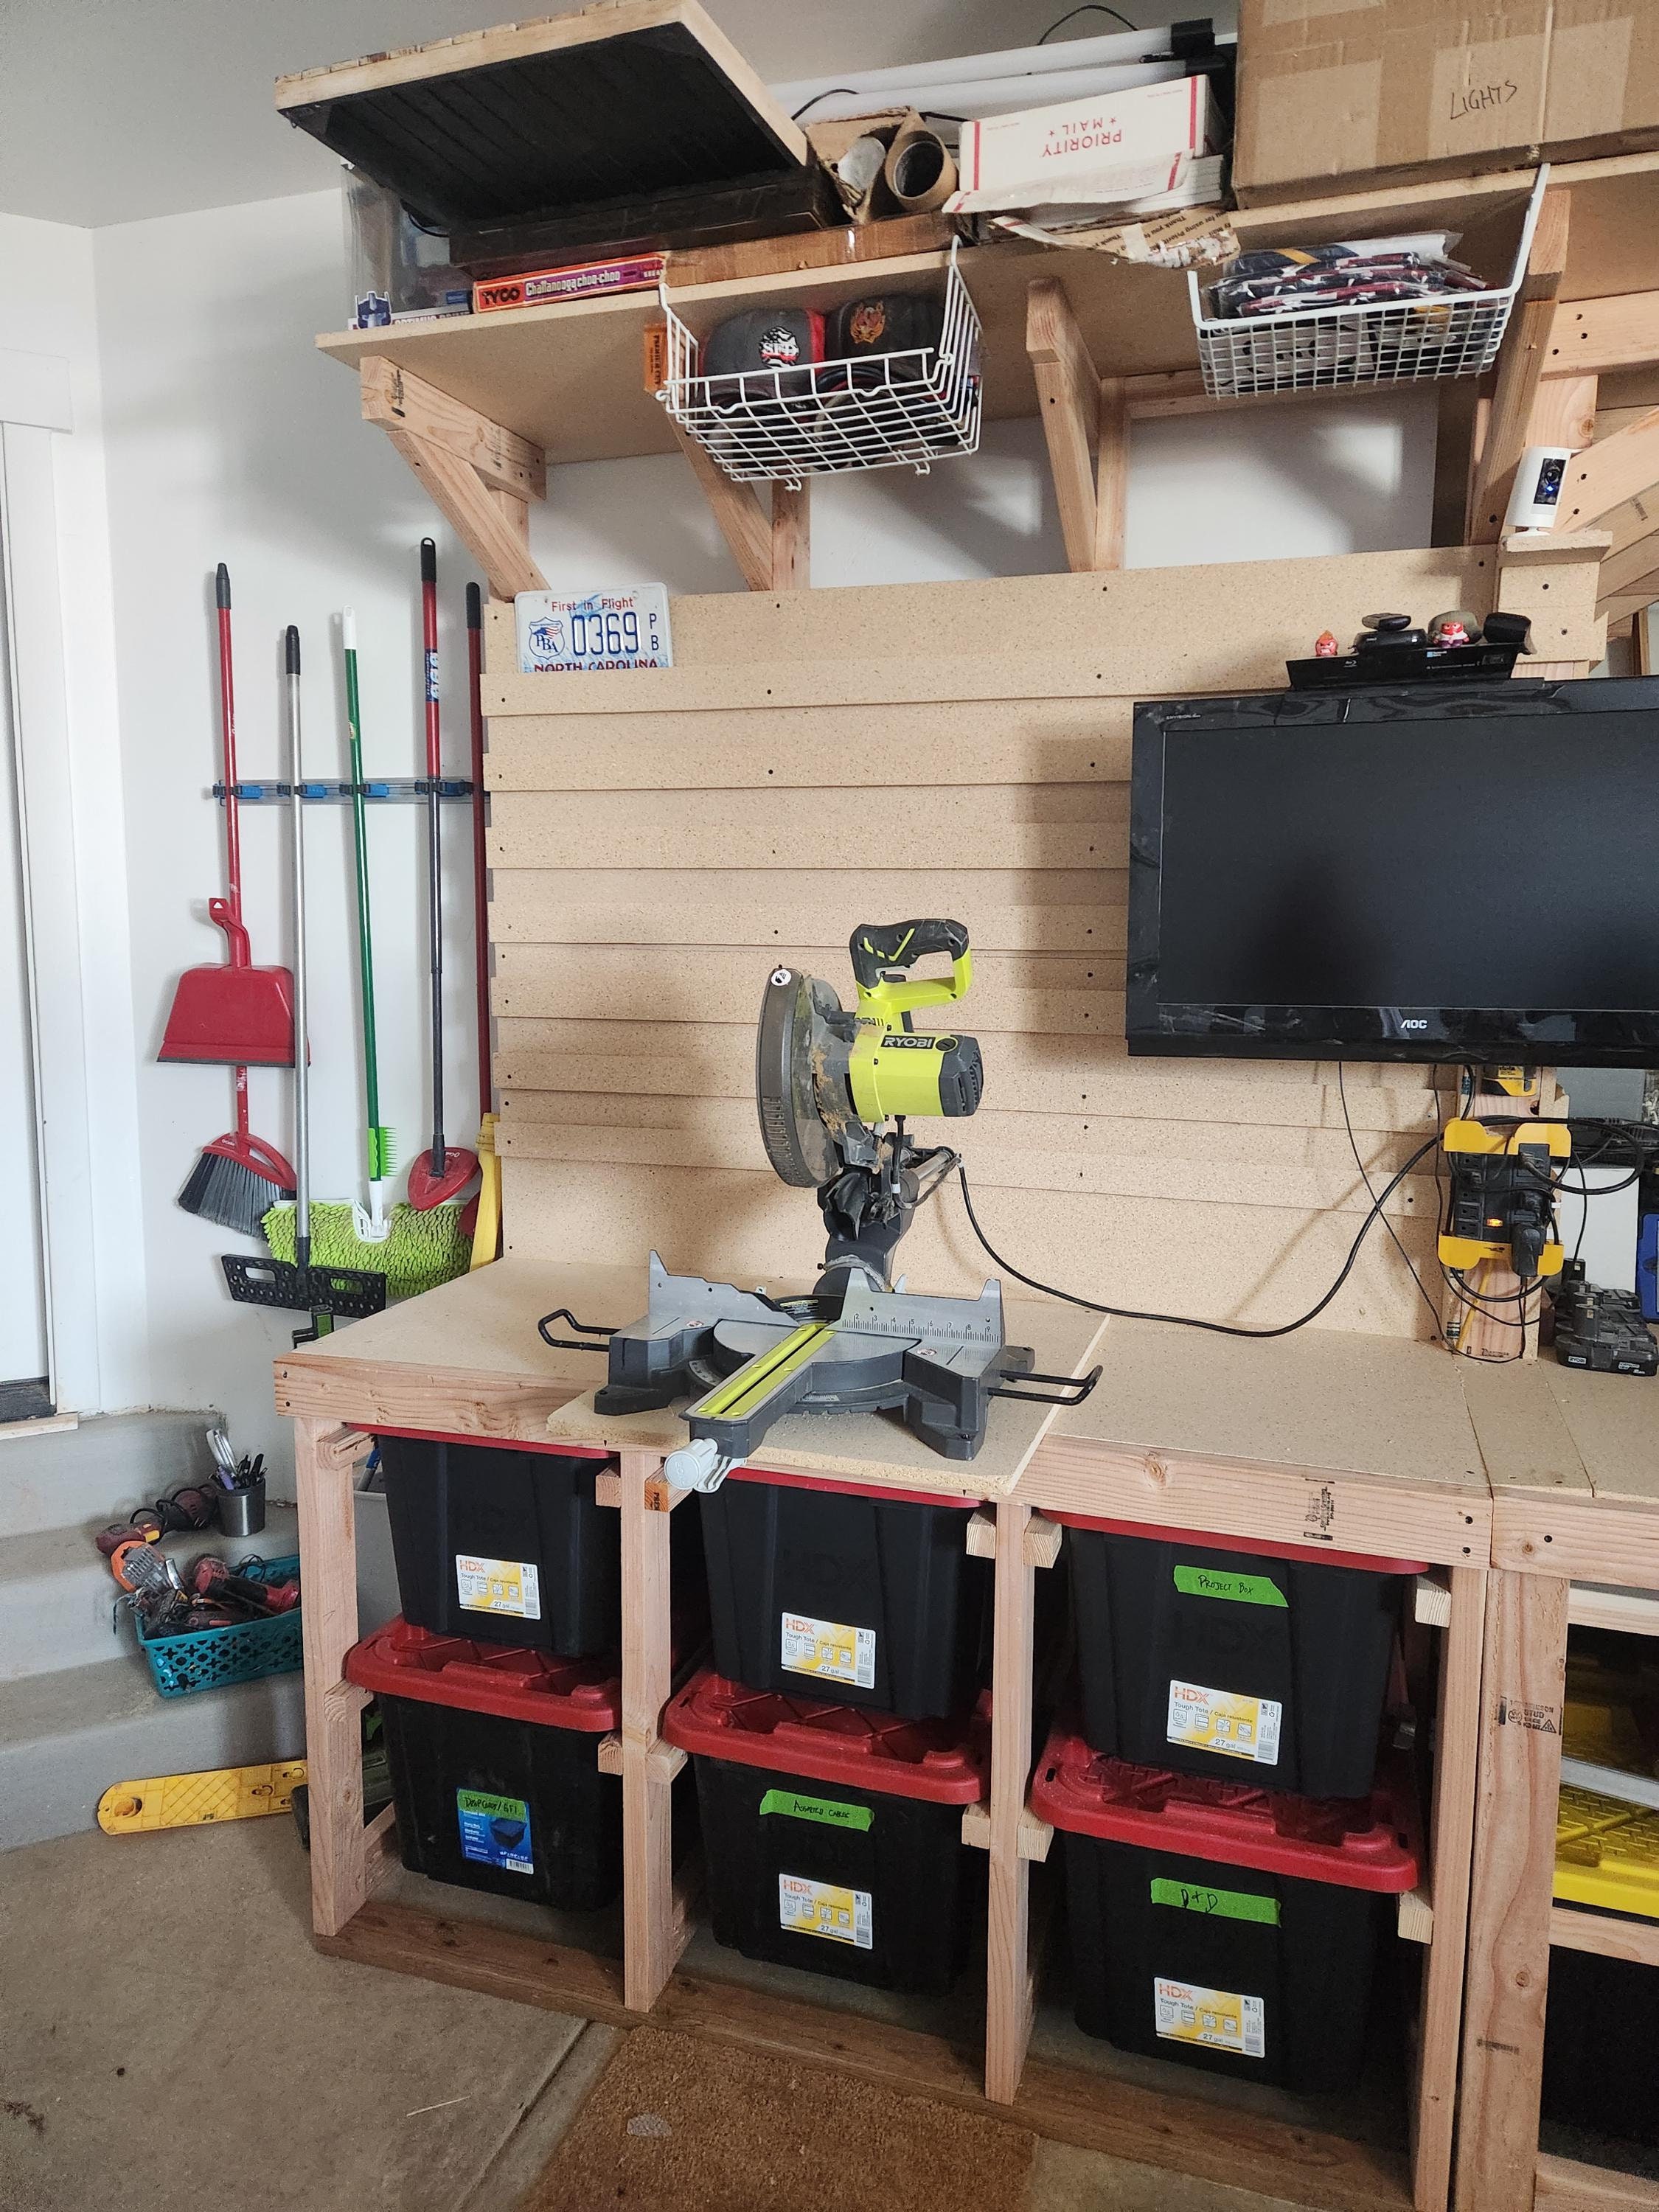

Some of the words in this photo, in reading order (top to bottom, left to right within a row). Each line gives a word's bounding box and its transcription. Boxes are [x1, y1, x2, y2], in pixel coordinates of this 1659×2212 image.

[1450, 80, 1517, 119] LIGHTS
[1062, 117, 1103, 135] MAIL
[1042, 129, 1123, 157] PRIORITY
[482, 288, 521, 305] TYCO
[526, 278, 577, 296] Chattanooga
[552, 601, 577, 612] First
[584, 600, 594, 609] in
[602, 597, 634, 610] Flight
[649, 613, 657, 629] P
[571, 611, 639, 656] 0369
[536, 634, 559, 653] PBA
[650, 635, 659, 650] B
[1400, 1019, 1427, 1029] AOC
[884, 1037, 933, 1048] RYOBI
[459, 1559, 485, 1573] HDX
[785, 1618, 815, 1635] HDX
[786, 1632, 802, 1641] Tough
[1175, 1686, 1209, 1705] HDX
[1174, 1702, 1194, 1711] Tough
[784, 1879, 813, 1895] HDX
[785, 1893, 801, 1901] Tough
[1159, 1983, 1193, 2001] HDX
[1160, 1998, 1179, 2007] Tough
